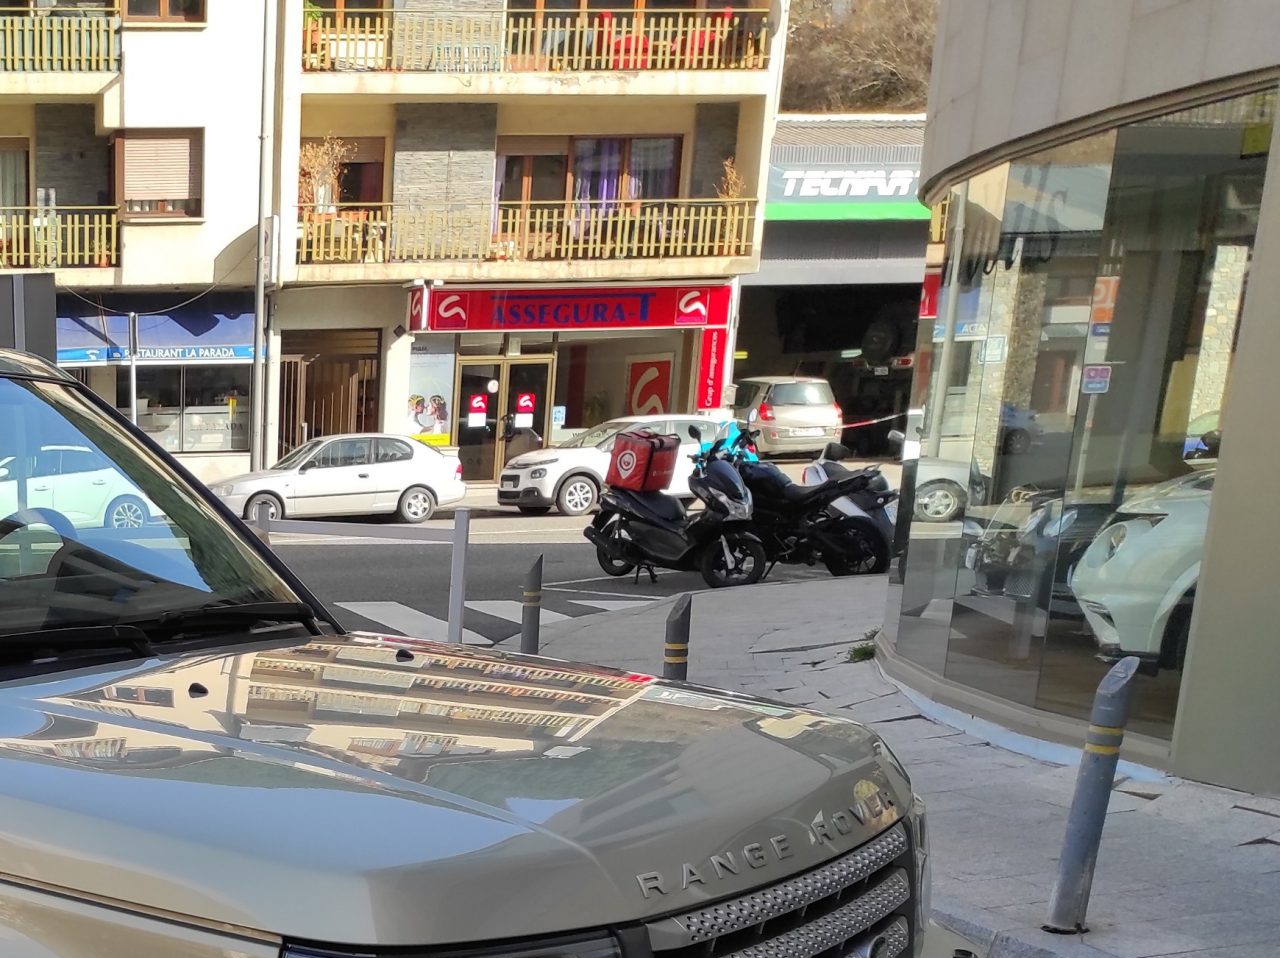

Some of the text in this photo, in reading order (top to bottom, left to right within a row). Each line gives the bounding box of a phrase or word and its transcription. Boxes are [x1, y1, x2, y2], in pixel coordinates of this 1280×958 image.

[490, 292, 656, 324] ASSEGURA-T
[125, 347, 235, 358] RSTAURANT LA PARADA
[705, 387, 714, 406] Grup
[635, 790, 895, 899] RANGE ROVER
